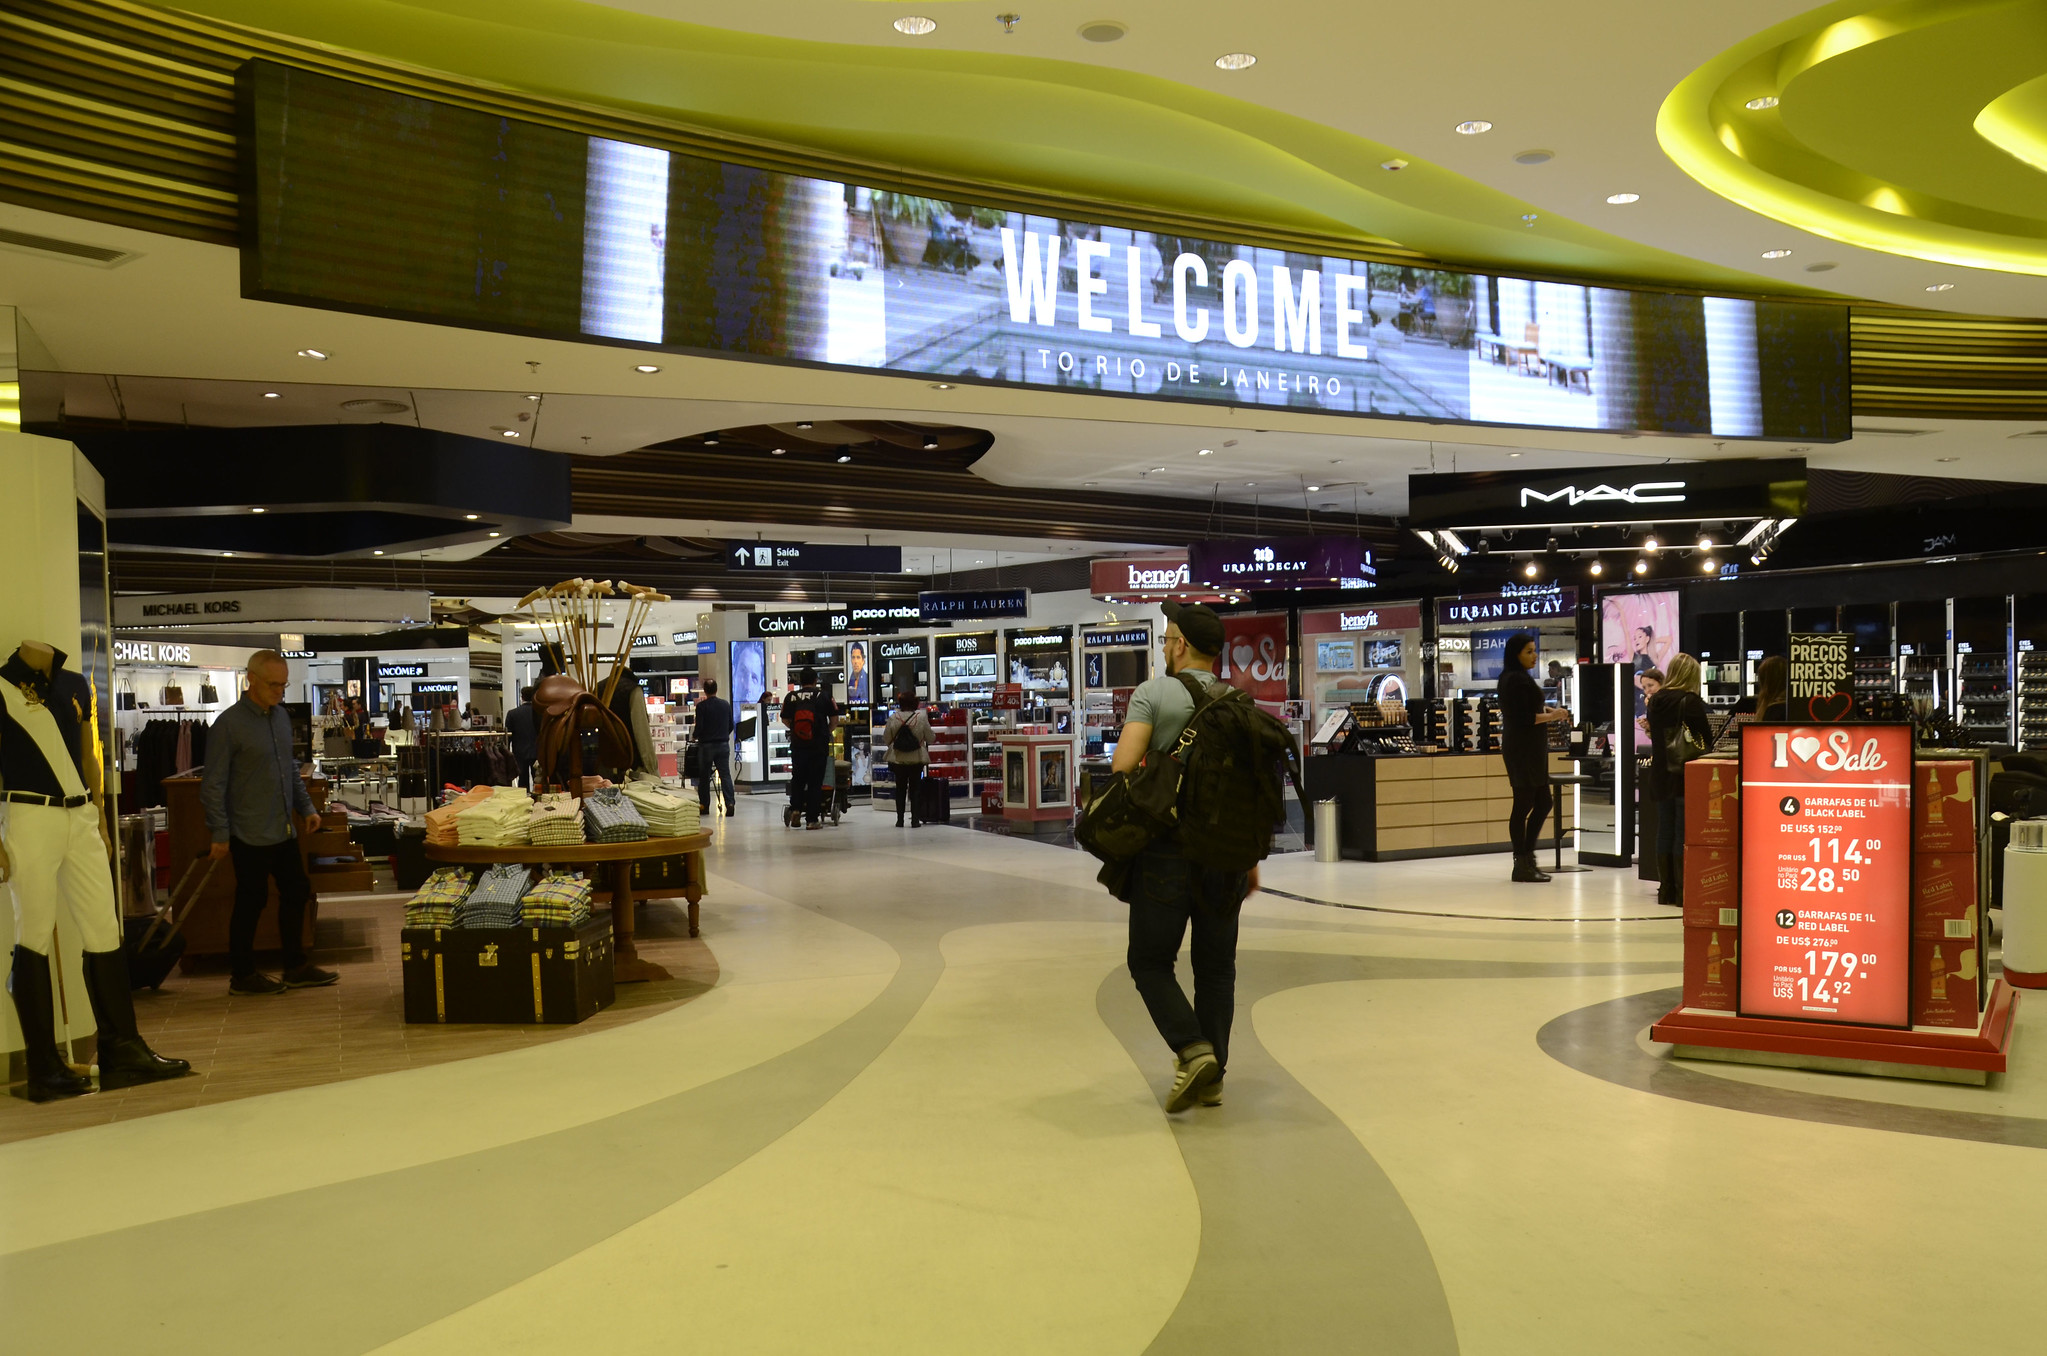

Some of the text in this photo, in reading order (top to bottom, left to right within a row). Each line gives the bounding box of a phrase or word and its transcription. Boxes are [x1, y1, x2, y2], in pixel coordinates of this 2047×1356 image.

[1000, 228, 1369, 360] WELCOME
[1038, 349, 1342, 396] TO RIO DE JANEIRO
[776, 547, 799, 557] Saída
[776, 559, 789, 567] Exit
[1222, 561, 1307, 574] URBAN DECAY
[1128, 563, 1190, 589] benefi
[143, 600, 241, 616] MICHAEL KORS
[923, 598, 1024, 612] RALPH LAUREN
[1450, 599, 1563, 622] URBAN DECAY
[852, 606, 920, 620] paco raba
[759, 616, 799, 631] Calvin
[831, 615, 848, 626] BO
[1340, 610, 1378, 630] benefit
[632, 636, 657, 646] LGARI
[956, 638, 978, 649] BOSS
[1014, 635, 1063, 647] paco rabanne
[1086, 632, 1146, 645] RALPH LAUREN
[114, 642, 191, 663] CHAEL KORS
[880, 643, 921, 657] Calvin Klein
[1790, 644, 1848, 665] PREÇOS
[378, 666, 416, 676] ANCÔME
[1790, 663, 1853, 680] IRRESIS-
[418, 684, 452, 693] LANCÔME
[1790, 678, 1836, 698] TÍVEIS
[1774, 731, 1888, 771] I Sale
[1784, 799, 1796, 813] 4
[1804, 797, 1879, 807] GARRAFAS DE 1L
[1804, 809, 1866, 818] BLACK LABEL
[1780, 824, 1793, 832] DE
[1795, 824, 1815, 834] US$
[1778, 877, 1798, 890] US$
[1922, 881, 1953, 895] Red Label
[1777, 912, 1795, 926] 12
[1798, 910, 1876, 922] GARRAFAS DE 1L
[1798, 923, 1850, 933] RED LABEL
[1776, 936, 1789, 944] DE
[1791, 937, 1811, 947] US$
[1774, 965, 1788, 973] POR
[1789, 966, 1802, 974] US$
[1773, 987, 1794, 999] US$
